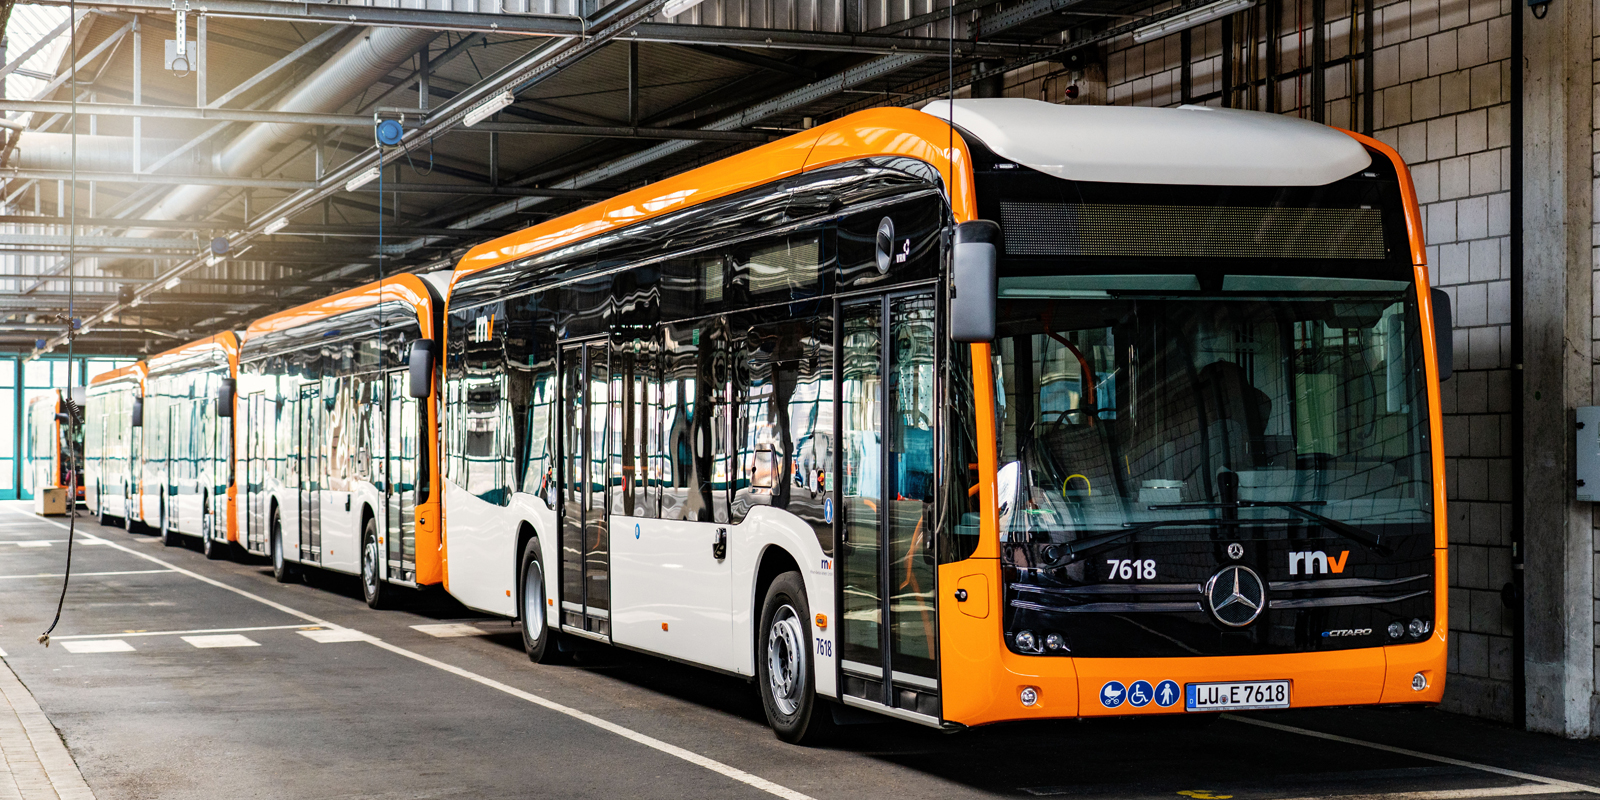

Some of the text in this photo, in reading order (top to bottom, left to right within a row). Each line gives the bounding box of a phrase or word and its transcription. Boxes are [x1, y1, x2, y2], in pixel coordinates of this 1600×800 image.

[475, 313, 495, 343] rnv
[821, 559, 832, 570] rnv
[1106, 559, 1157, 580] 7618
[1288, 550, 1350, 575] rnv
[1321, 628, 1372, 637] eCITARO
[815, 637, 832, 658] 7618
[1197, 687, 1219, 705] LU
[1230, 686, 1241, 704] E
[1244, 684, 1285, 703] 7618
